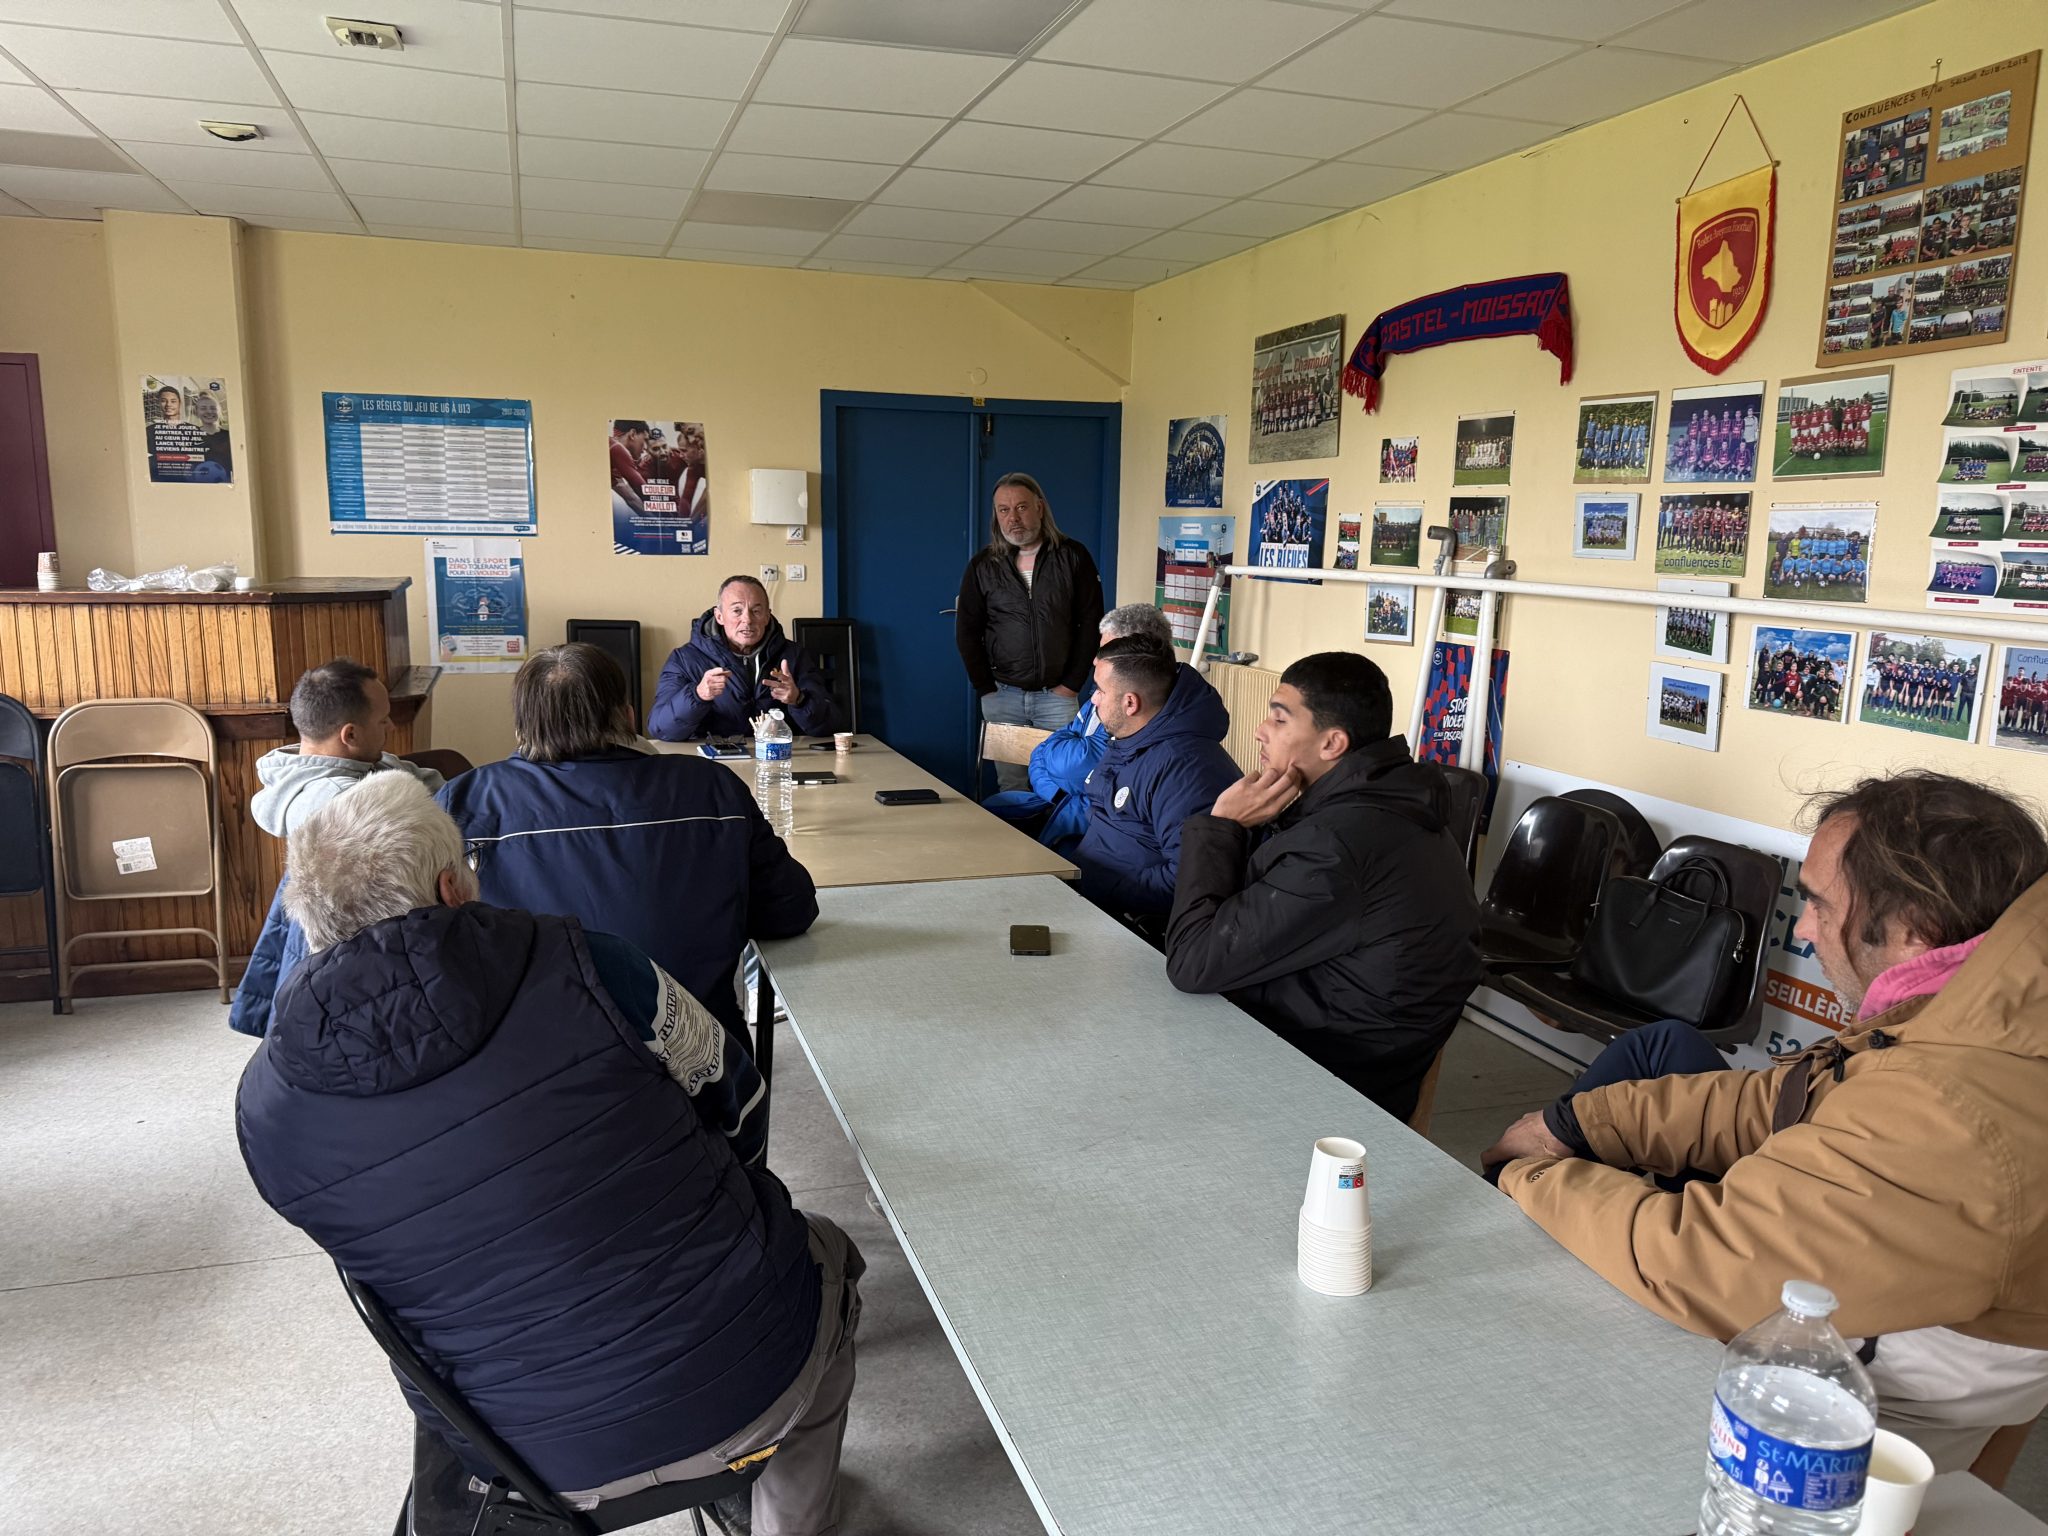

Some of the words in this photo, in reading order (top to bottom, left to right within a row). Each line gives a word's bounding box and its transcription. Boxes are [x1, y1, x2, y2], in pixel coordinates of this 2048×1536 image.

[1845, 93, 1916, 124] CONFLUENCES
[1294, 352, 1334, 372] Champion
[2012, 365, 2043, 375] ENTENTE
[362, 399, 375, 411] LES
[403, 401, 413, 412] DU
[414, 402, 428, 413] JEU
[429, 402, 439, 413] DE
[458, 403, 471, 414] U13
[644, 486, 674, 495] COULEUR
[645, 502, 675, 511] MAILLOT
[1260, 547, 1275, 567] LES
[1663, 555, 1720, 568] confluences
[1722, 556, 1732, 568] fc
